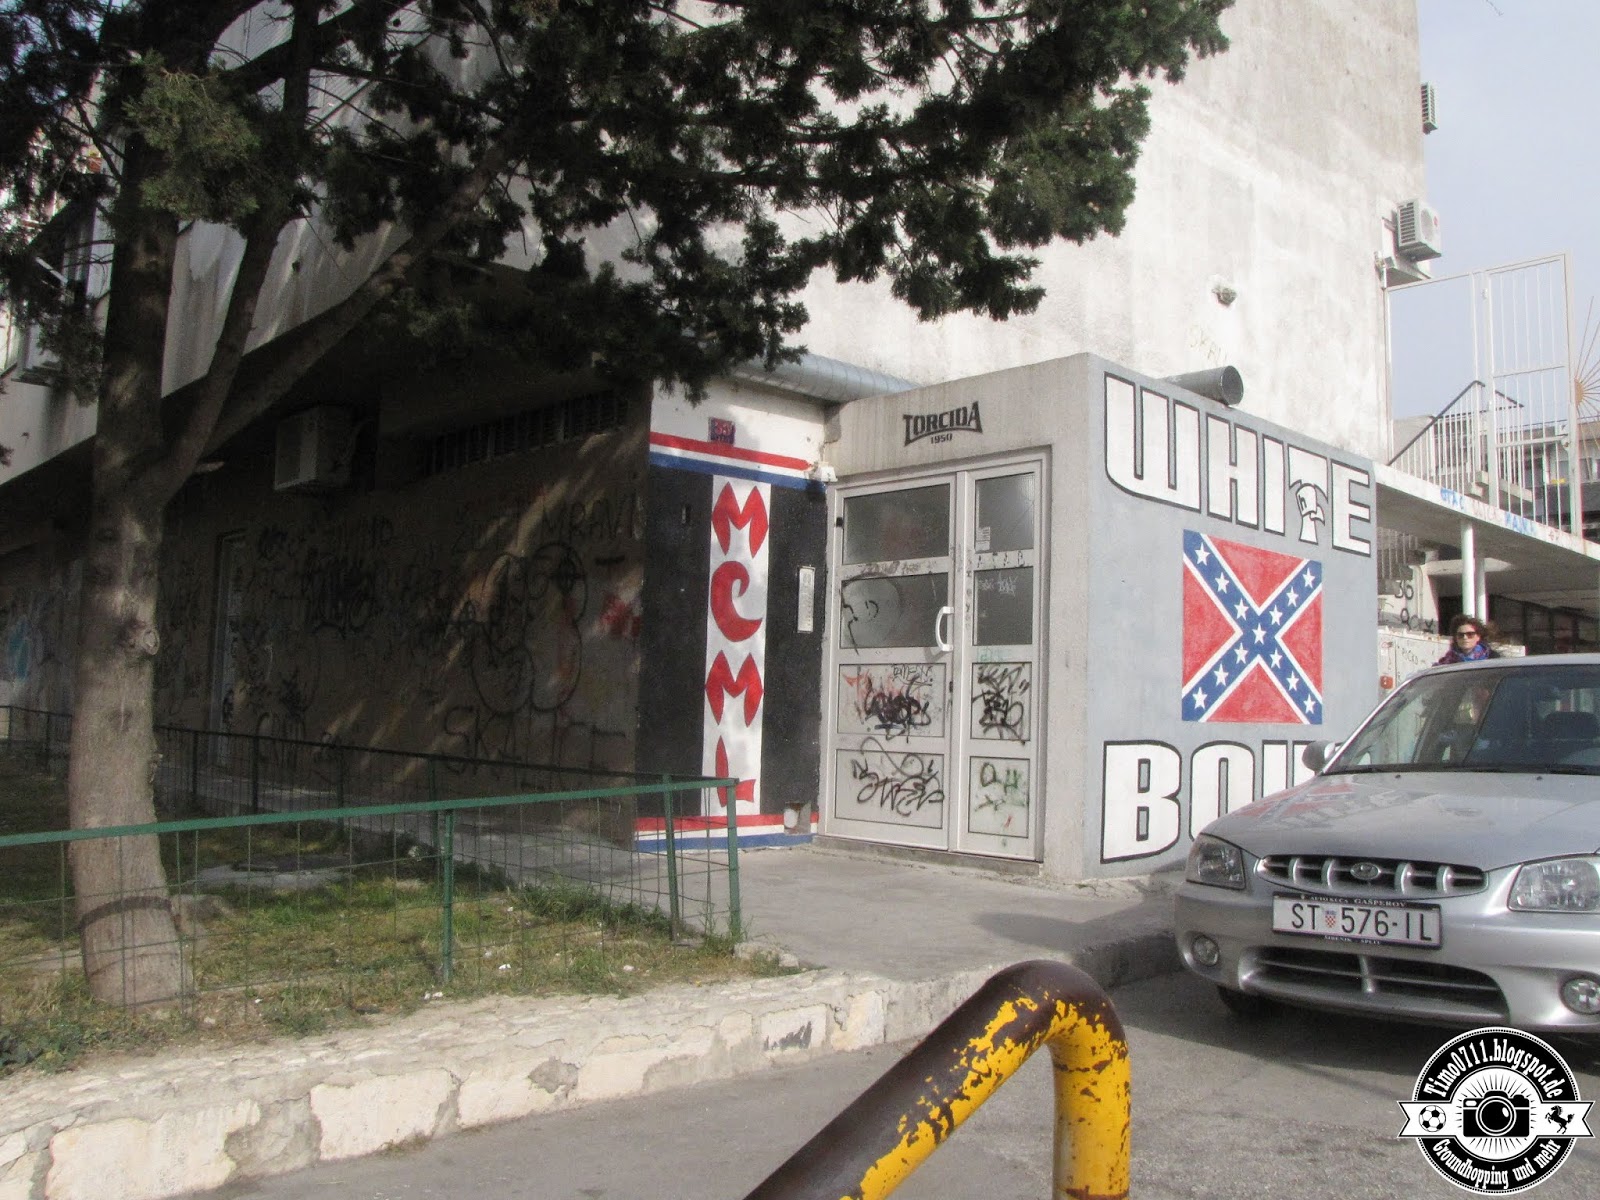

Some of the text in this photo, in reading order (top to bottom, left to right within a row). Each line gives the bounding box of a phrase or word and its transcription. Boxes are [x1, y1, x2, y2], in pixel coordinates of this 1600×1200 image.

[903, 401, 983, 447] TORCIDA
[930, 433, 953, 445] 1950
[1104, 371, 1372, 558] WHITE
[1291, 902, 1432, 942] ST 576-IL
